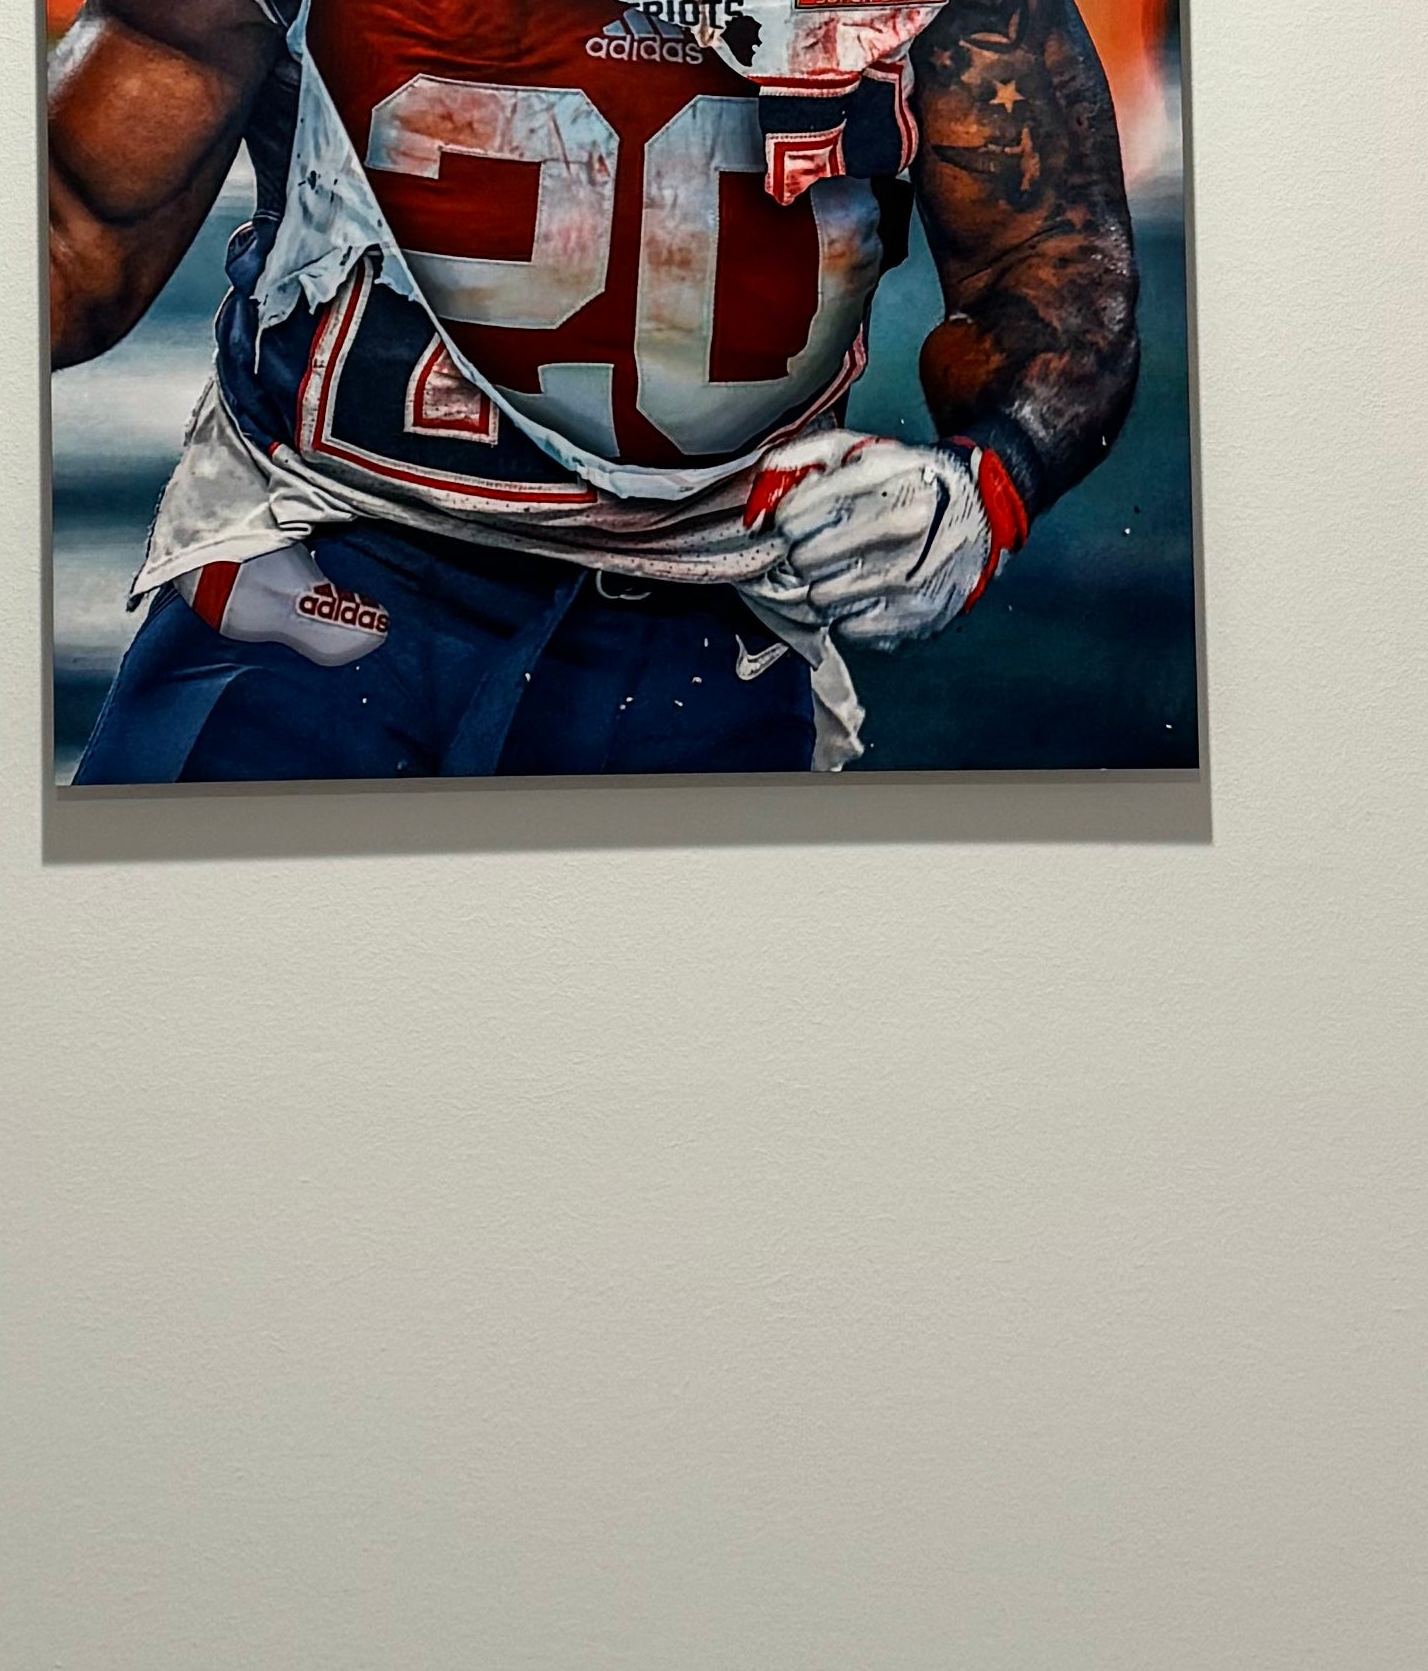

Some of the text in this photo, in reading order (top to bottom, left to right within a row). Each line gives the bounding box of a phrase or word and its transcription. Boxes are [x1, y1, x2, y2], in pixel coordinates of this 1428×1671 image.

[585, 34, 704, 65] adidas
[365, 73, 883, 457] 20
[299, 595, 390, 633] adidas
